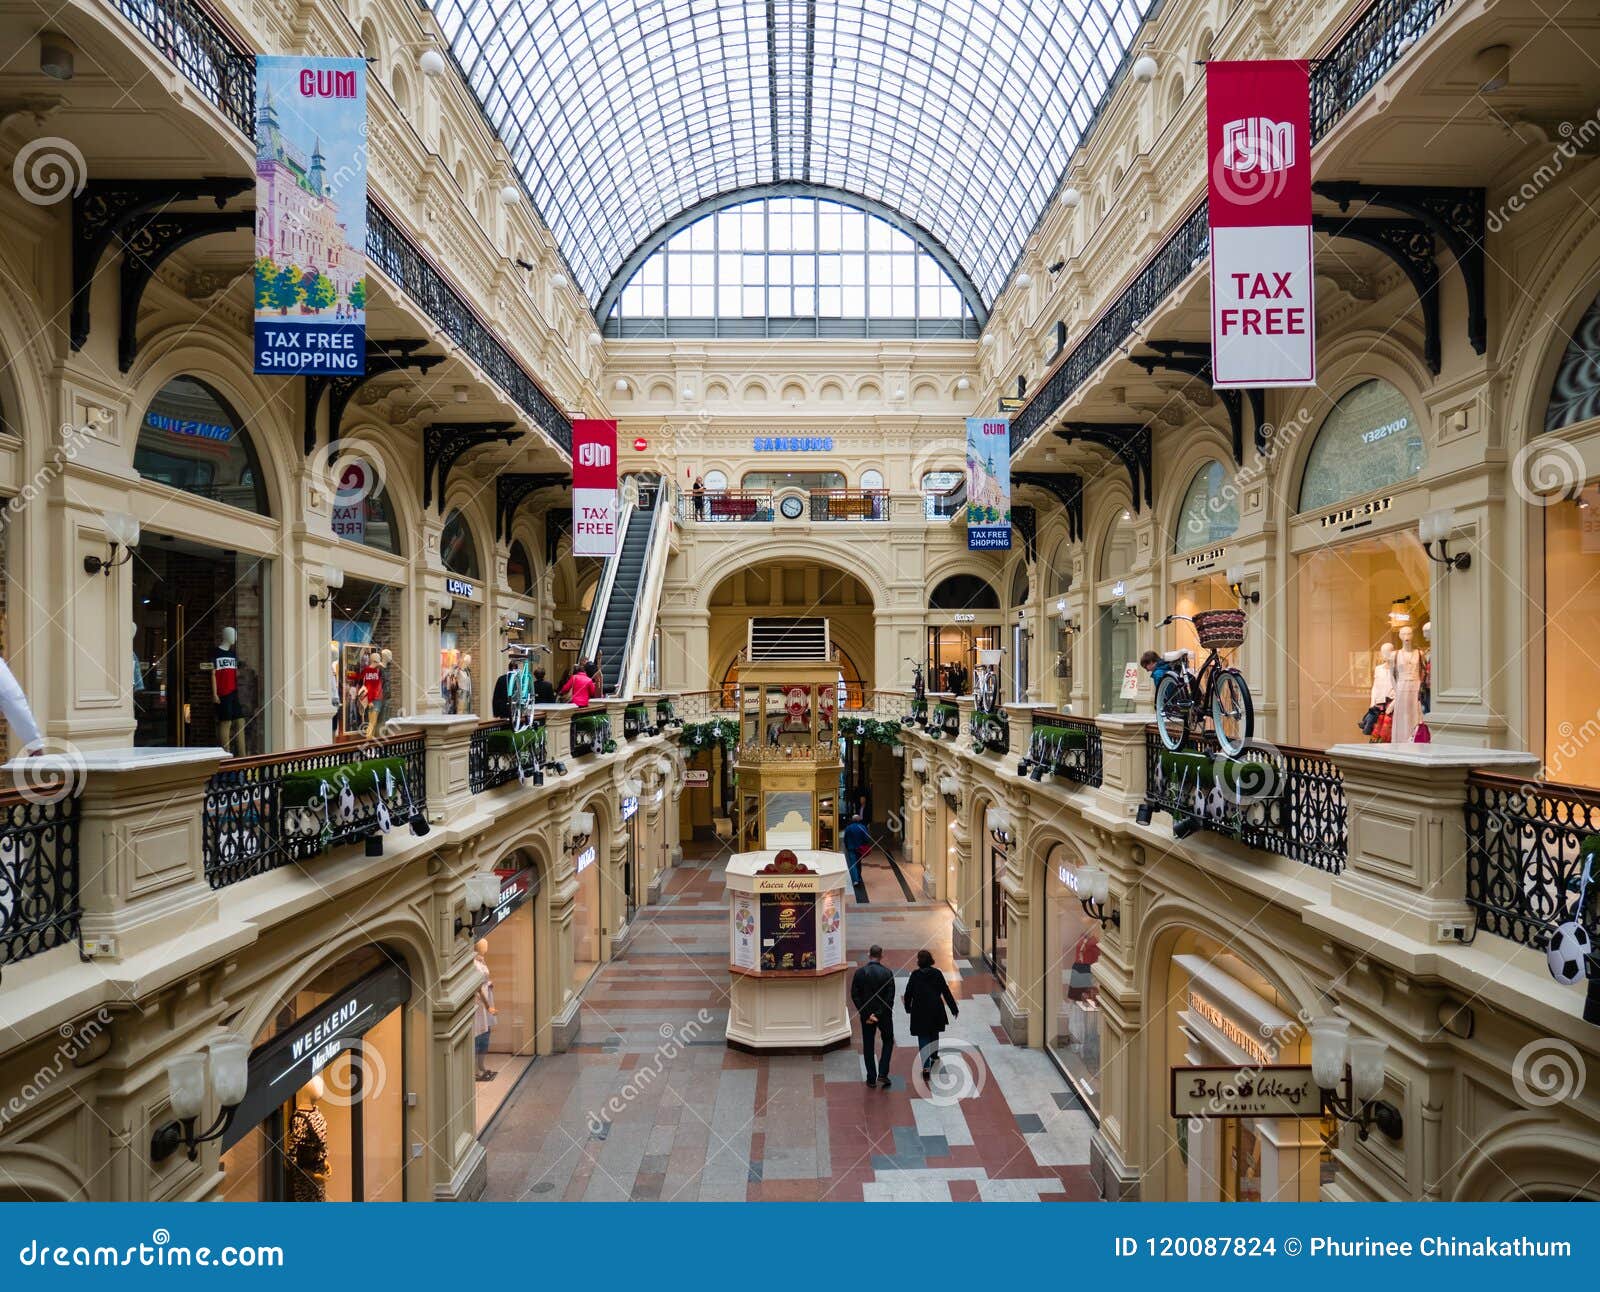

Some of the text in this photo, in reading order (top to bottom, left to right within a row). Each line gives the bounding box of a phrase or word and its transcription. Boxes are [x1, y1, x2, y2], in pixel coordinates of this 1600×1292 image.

[300, 69, 358, 98] GUM
[1231, 272, 1293, 299] TAX
[1221, 308, 1305, 336] FREE
[264, 332, 354, 349] TAX FREE
[261, 351, 358, 368] SHOPPING
[983, 423, 1005, 435] GUM
[753, 436, 833, 452] SAMSUNG
[582, 507, 608, 519] TAX
[577, 522, 614, 535] FREE
[972, 531, 1007, 539] TAX FREE
[970, 539, 1009, 547] SHOPPING
[292, 999, 357, 1060] WEEKEND
